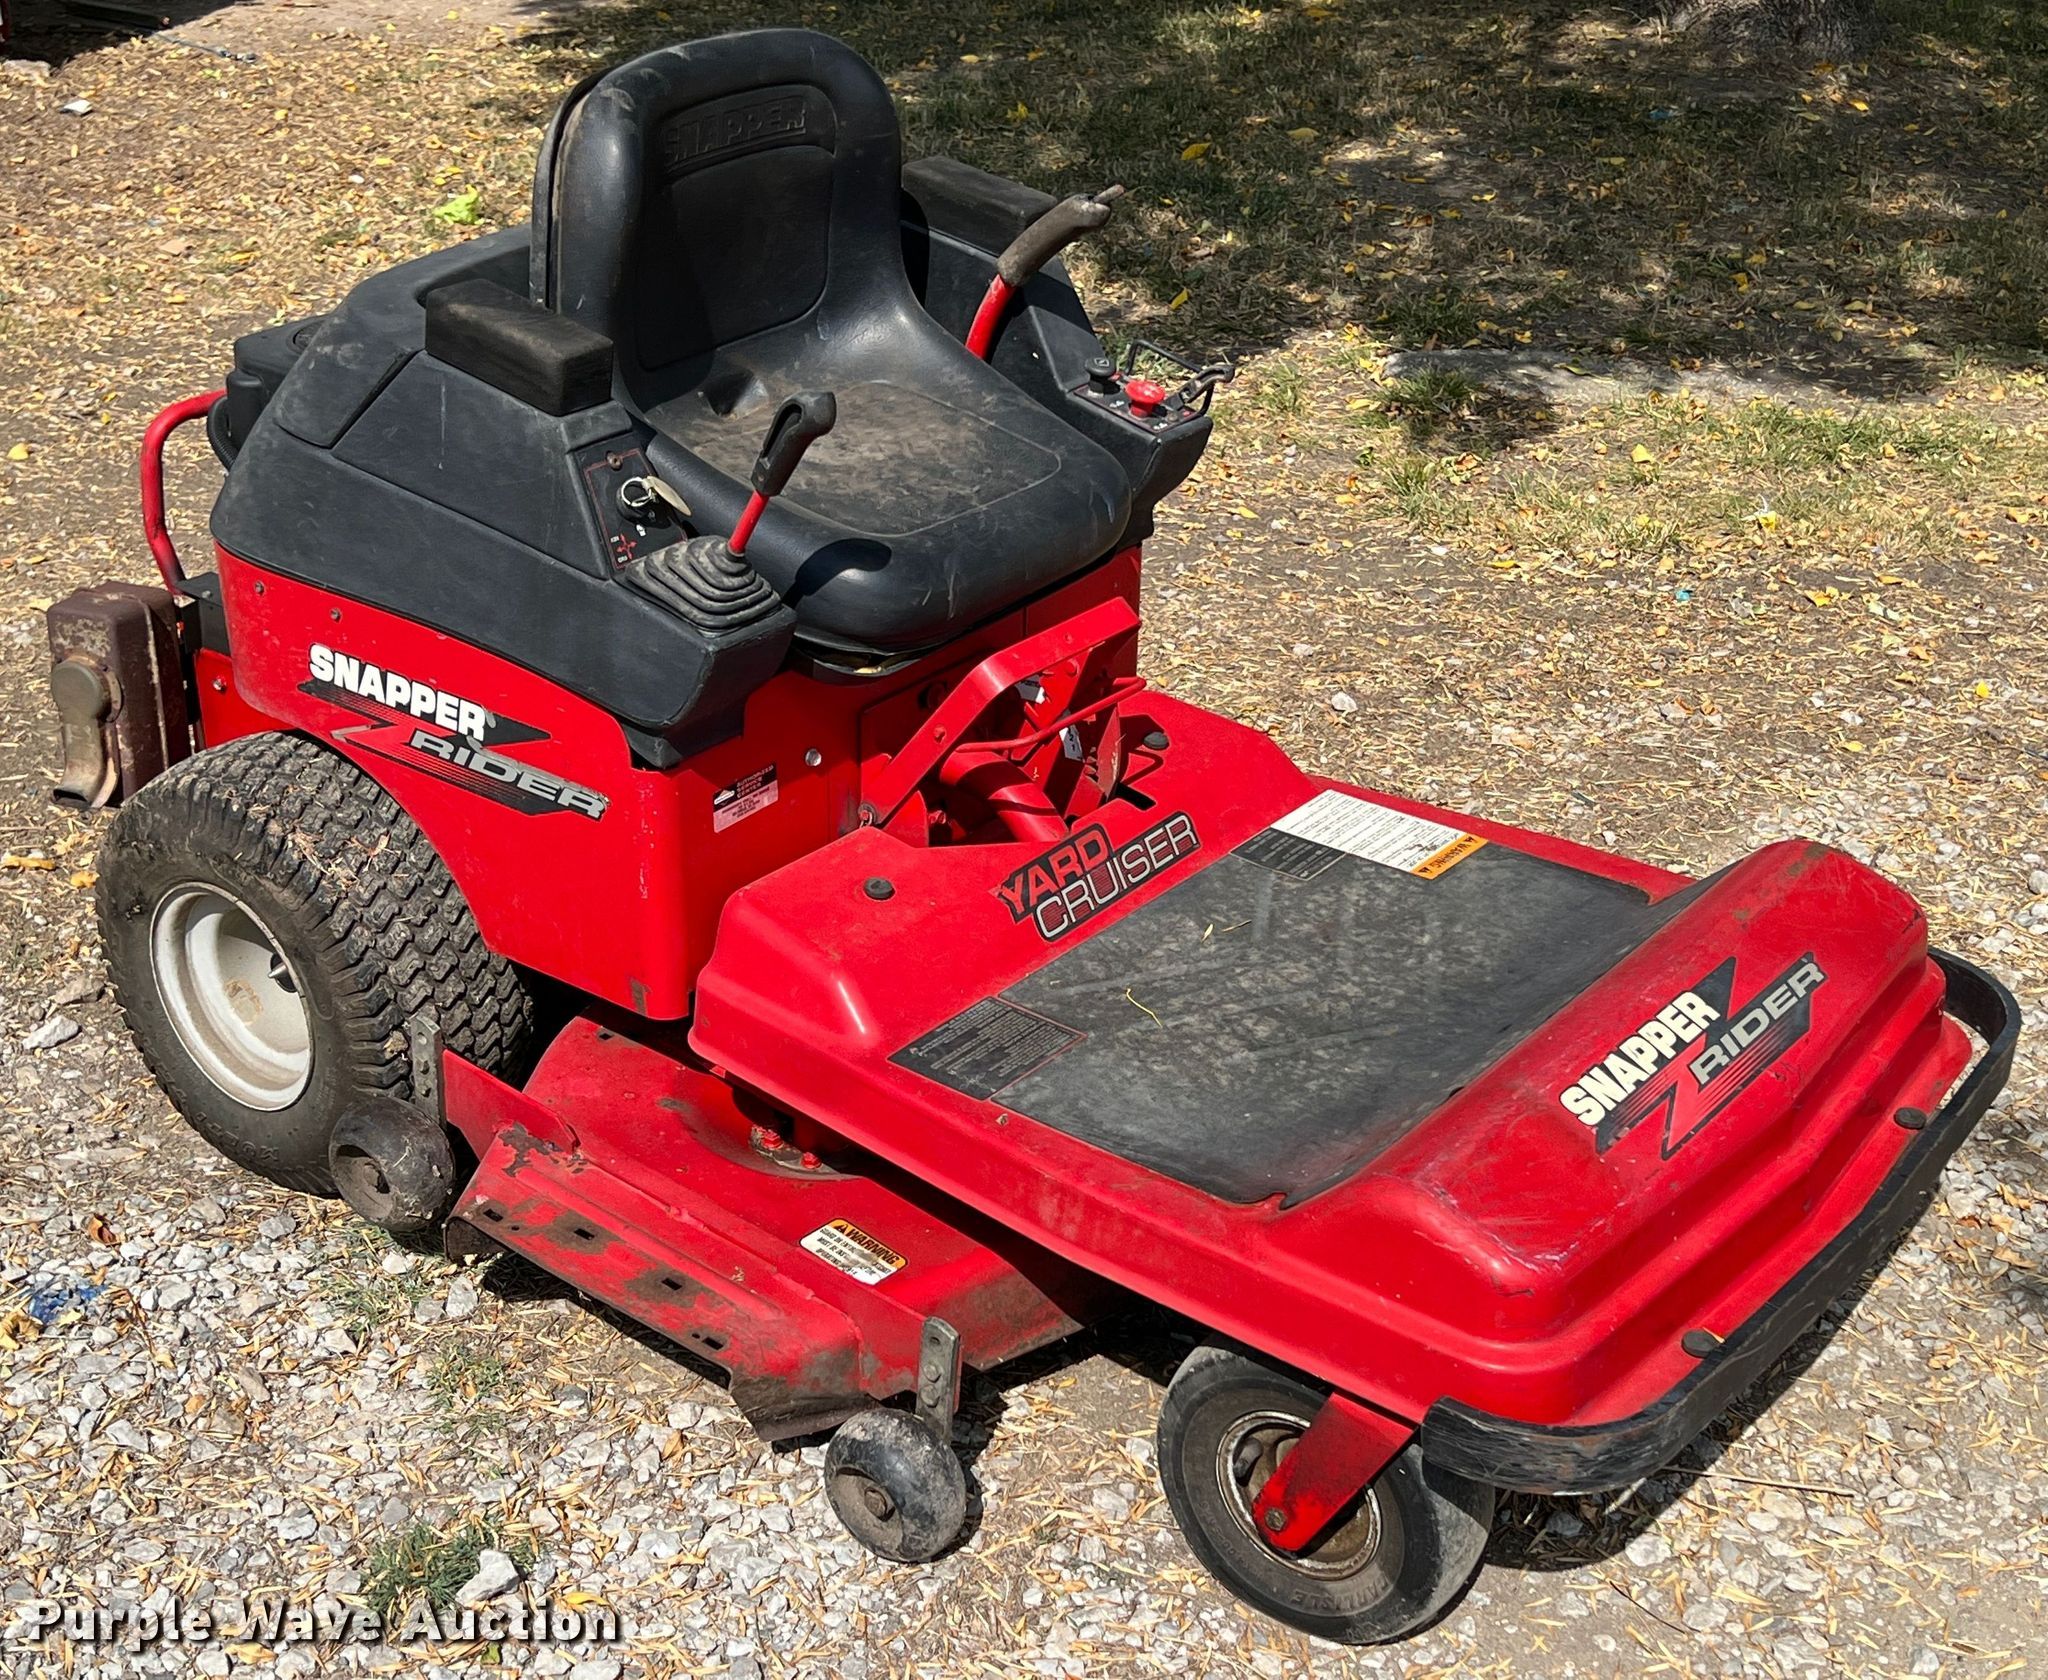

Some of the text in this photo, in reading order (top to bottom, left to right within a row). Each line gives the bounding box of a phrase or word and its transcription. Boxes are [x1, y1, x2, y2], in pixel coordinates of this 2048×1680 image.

[309, 644, 486, 741] SNAPPER
[410, 730, 606, 819] RIDER
[1000, 829, 1109, 914] YARD
[1036, 814, 1198, 939] CRUISER
[1559, 991, 1721, 1126] SNAPPER
[1689, 962, 1826, 1085] RIDER
[845, 1228, 901, 1265] WARNING
